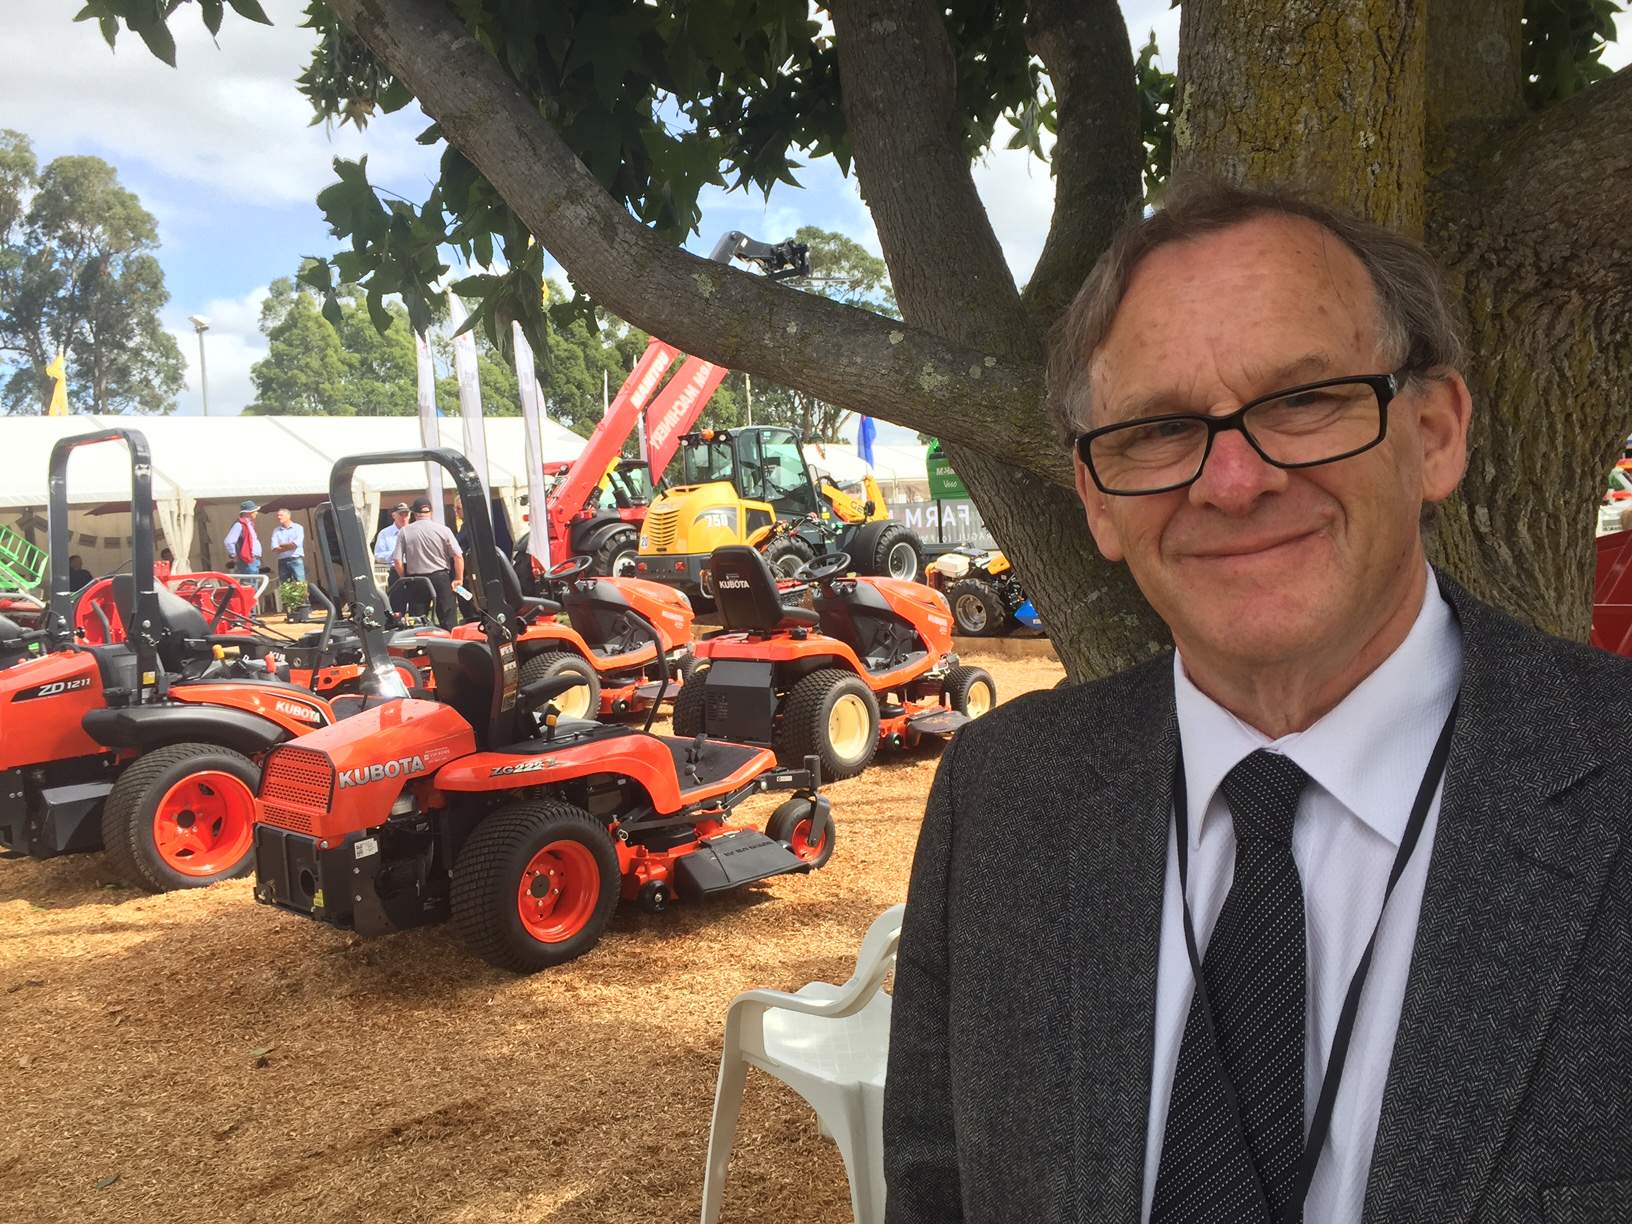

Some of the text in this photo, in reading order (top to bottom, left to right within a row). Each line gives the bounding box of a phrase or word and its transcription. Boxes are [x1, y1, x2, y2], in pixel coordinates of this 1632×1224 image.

[630, 350, 669, 409] MANITOU
[719, 580, 751, 589] KUBOTA
[275, 700, 321, 722] KUBOTA
[338, 755, 425, 789] KUBOTA
